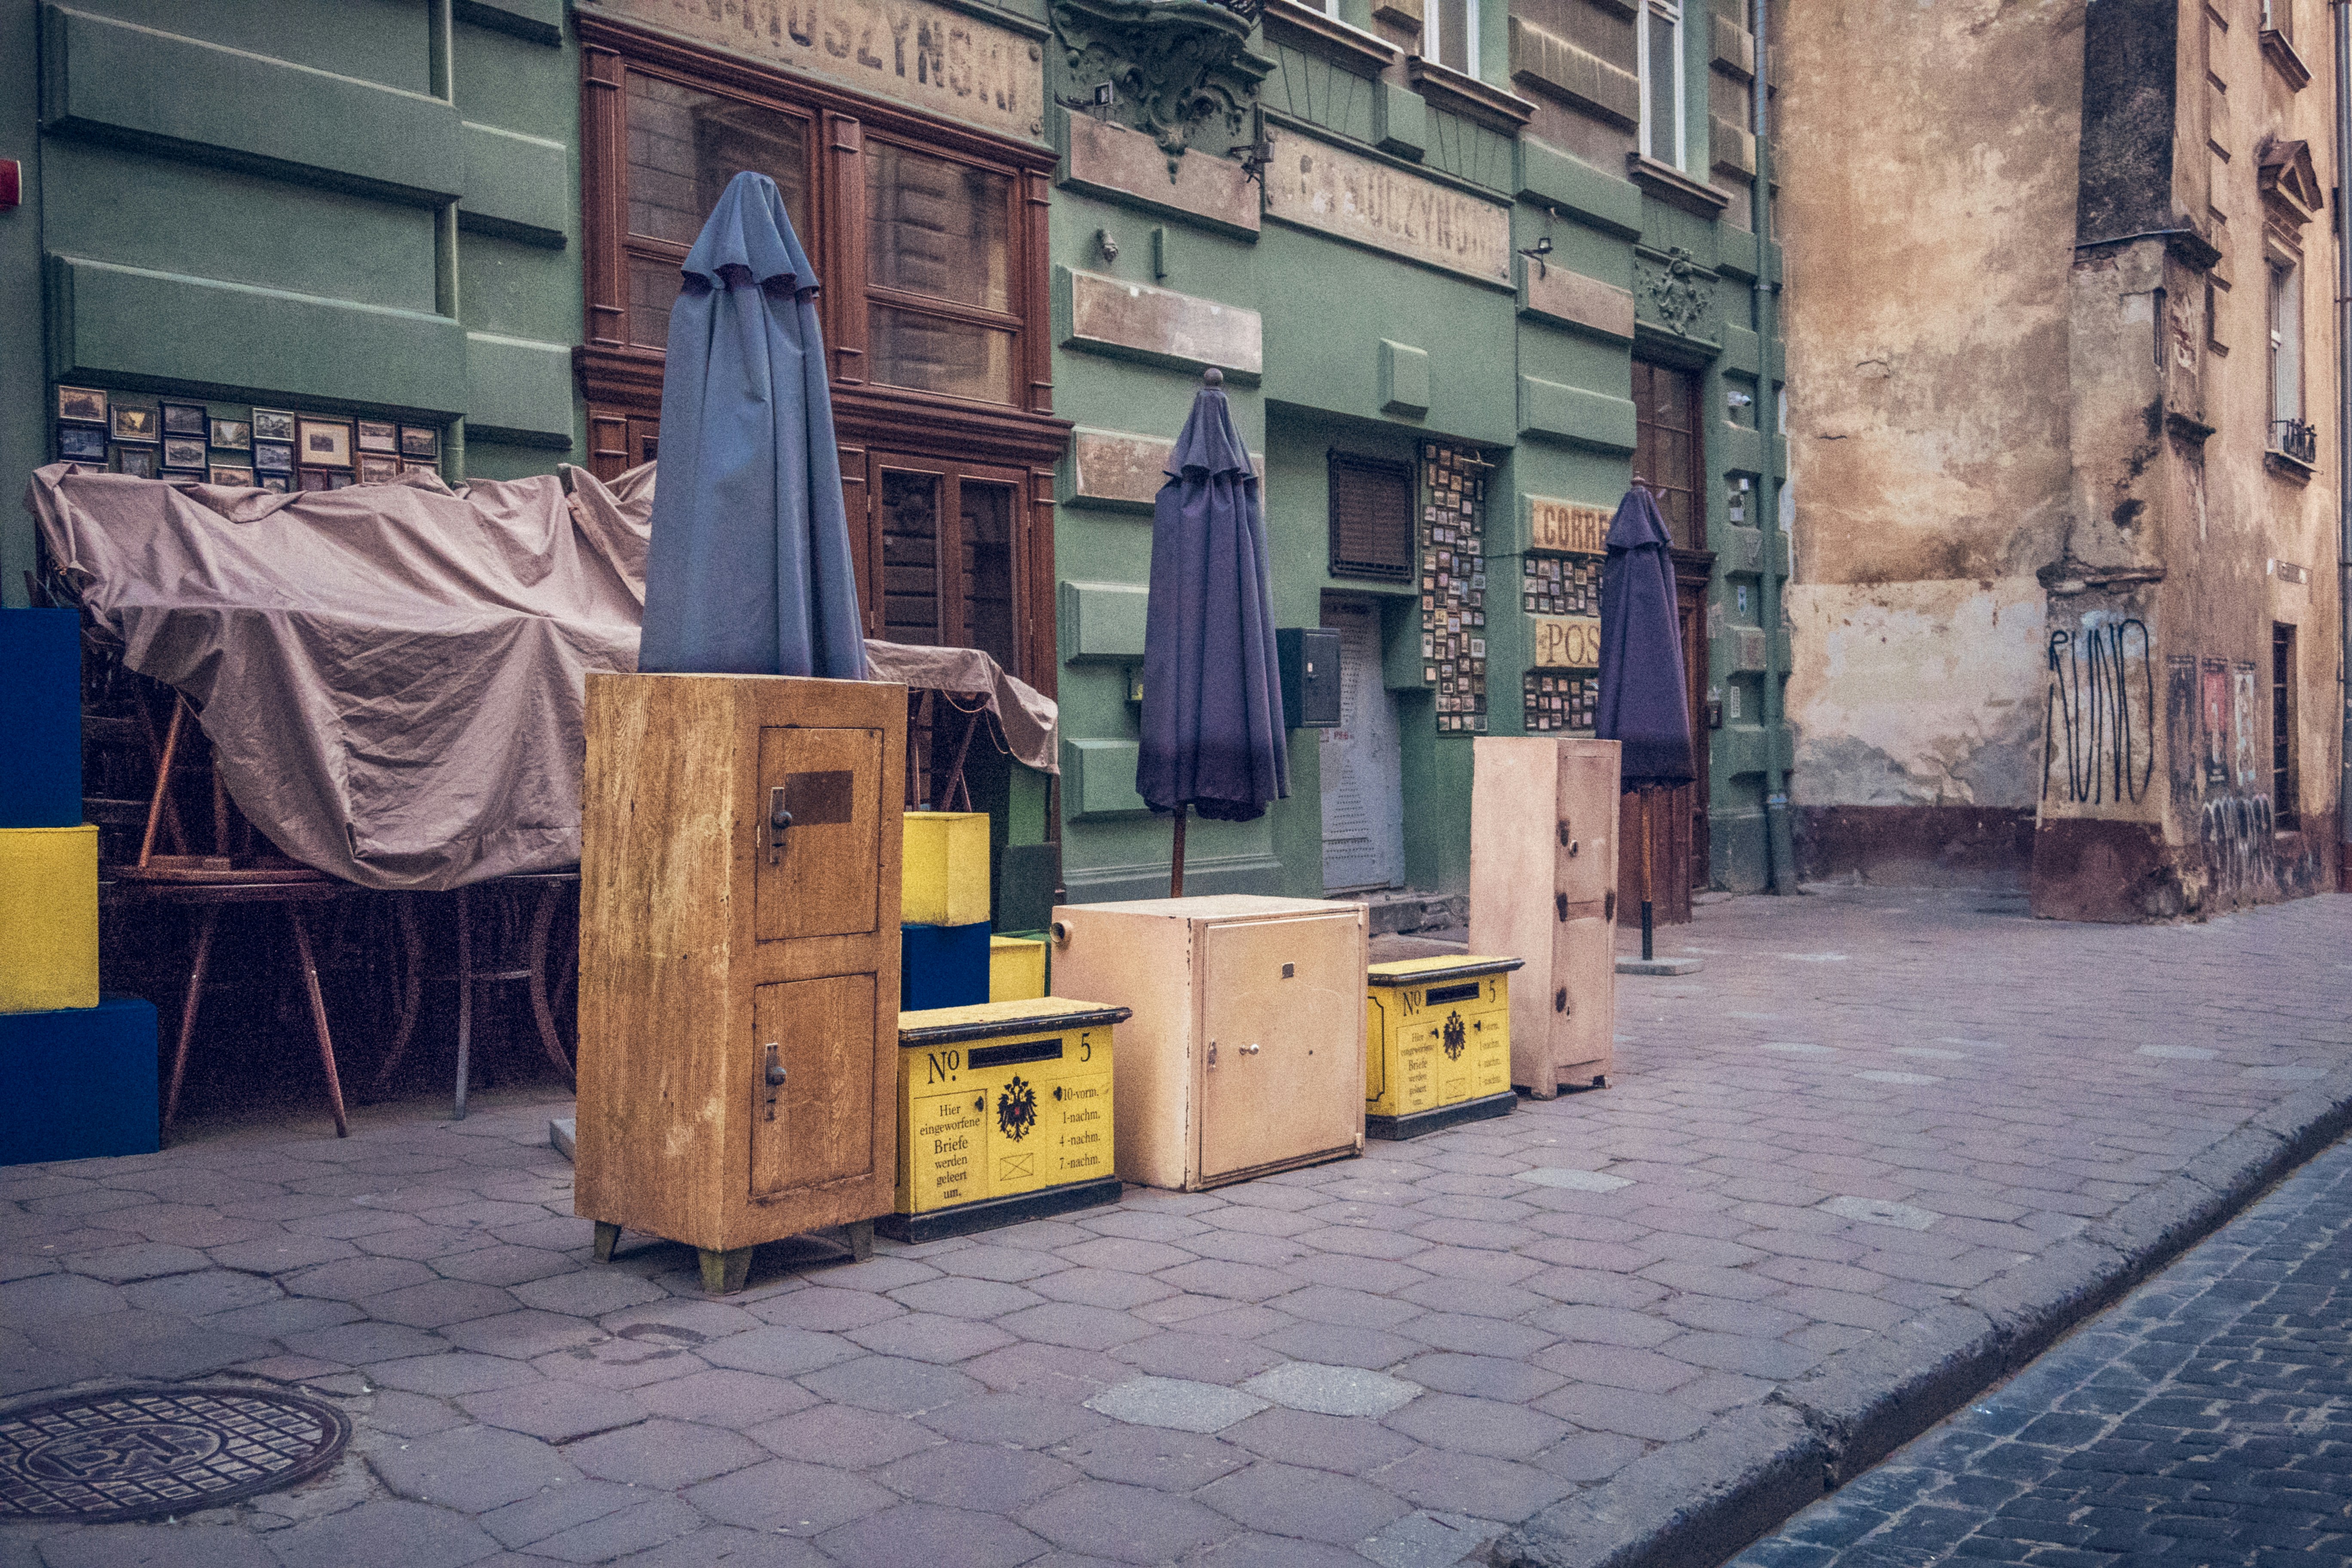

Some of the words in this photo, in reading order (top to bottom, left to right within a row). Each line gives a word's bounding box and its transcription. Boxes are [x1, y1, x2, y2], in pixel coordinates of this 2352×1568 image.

[1489, 980, 1496, 1003] 5
[1081, 1032, 1091, 1062] 5
[940, 1104, 961, 1117] Hier
[920, 1117, 980, 1136] eingeworfene
[934, 1135, 968, 1155] Briefe
[935, 1155, 968, 1170] werden
[937, 1171, 967, 1188] geleert
[943, 1188, 962, 1199] um.
